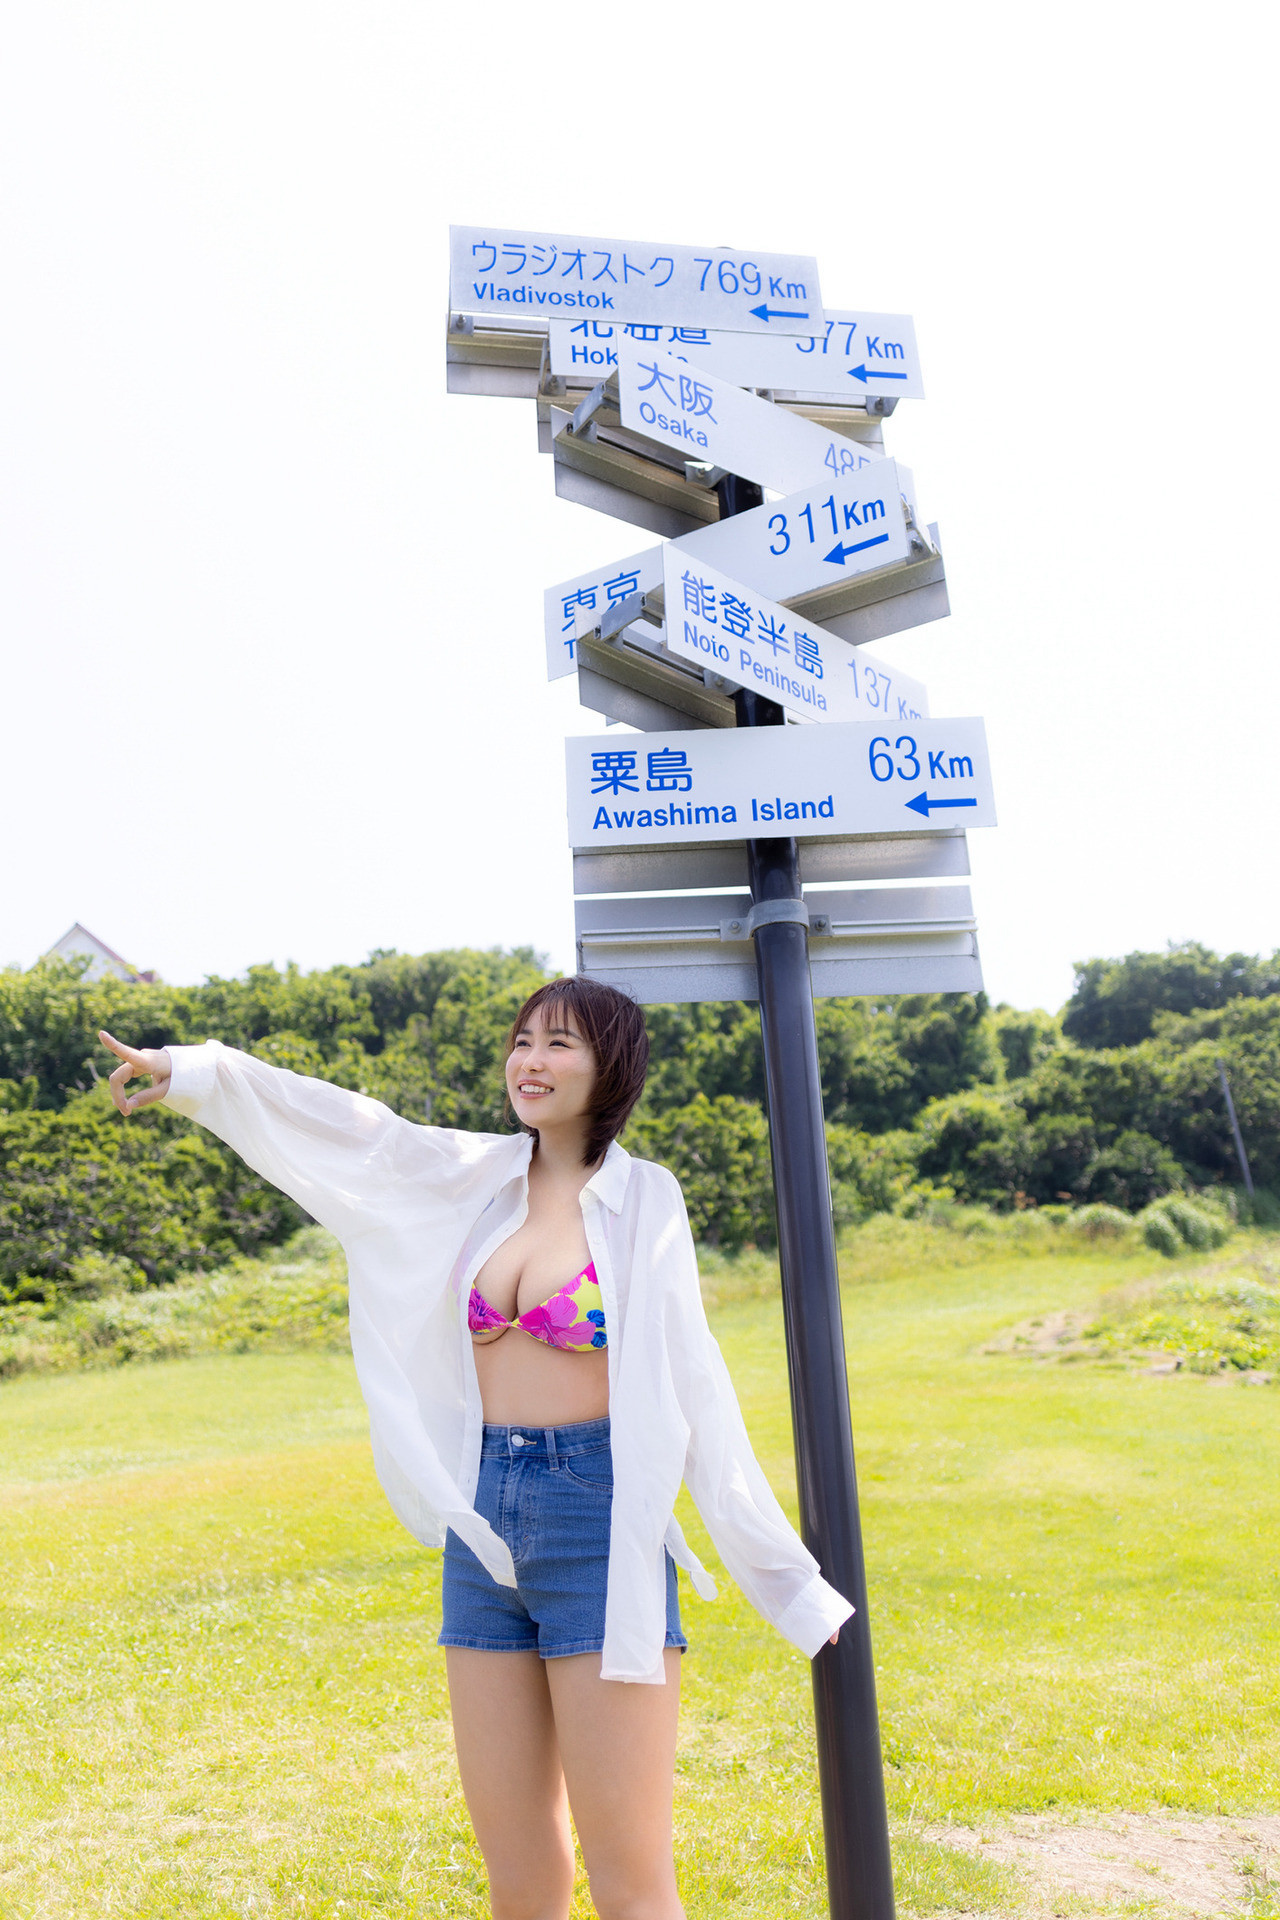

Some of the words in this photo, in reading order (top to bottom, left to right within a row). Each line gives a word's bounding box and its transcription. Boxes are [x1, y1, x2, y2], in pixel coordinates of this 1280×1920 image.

[472, 239, 674, 289] ウラジオストク
[693, 257, 763, 297] 769
[768, 275, 808, 301] Km
[472, 281, 615, 311] Vladivostok
[866, 335, 905, 360] Km
[637, 361, 719, 425] 大阪
[638, 401, 709, 448] Osaka
[680, 569, 824, 680] 能登半島
[847, 658, 892, 713] 137
[739, 648, 828, 712] Peninsula
[590, 746, 694, 797] 粟島
[868, 735, 922, 783] 63
[928, 749, 975, 779] Km
[592, 801, 738, 831] Awashima
[751, 794, 836, 822] Island
